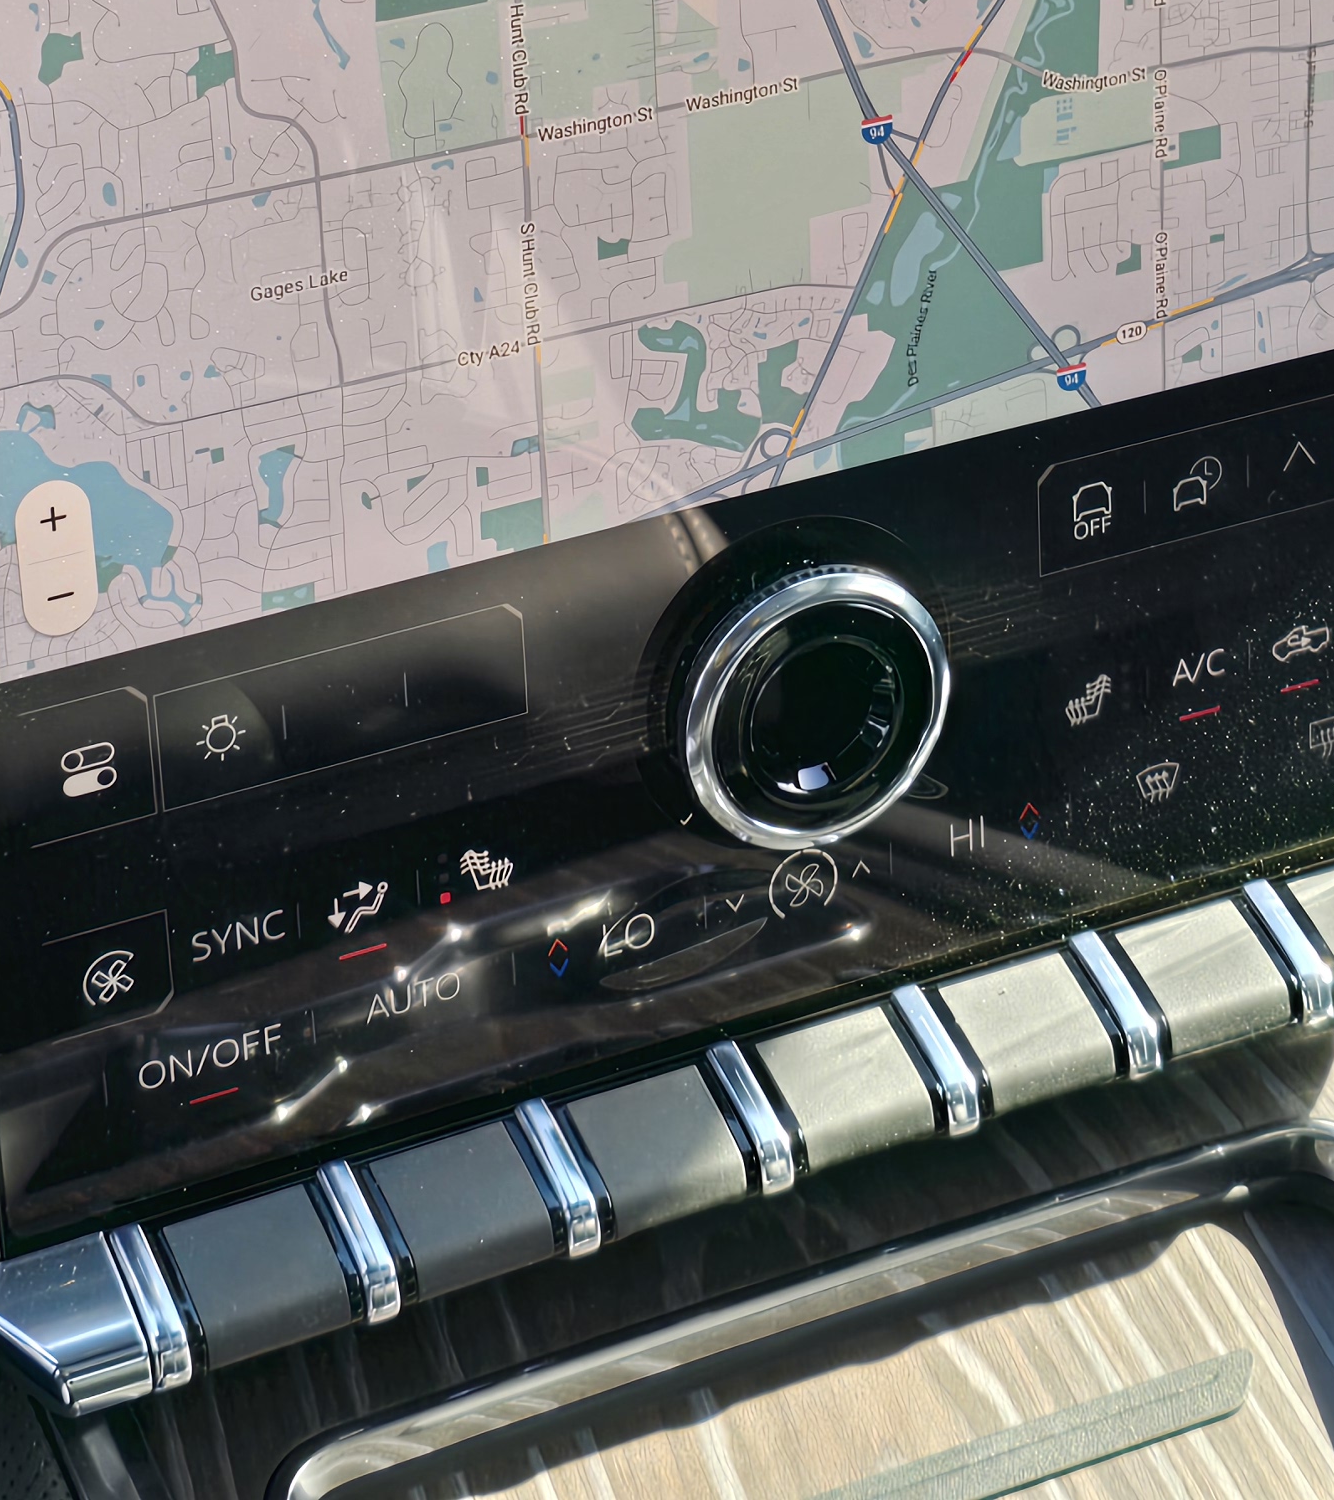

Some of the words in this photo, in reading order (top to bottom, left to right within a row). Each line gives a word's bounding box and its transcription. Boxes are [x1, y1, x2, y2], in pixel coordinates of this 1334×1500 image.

[510, 4, 524, 45] Hunt
[512, 50, 528, 88] Club
[1042, 70, 1127, 92] Washington
[1132, 67, 1146, 82] St
[514, 92, 529, 115] Rd
[686, 82, 778, 111] Washington
[783, 78, 798, 92] St
[1154, 69, 1167, 132] O'Plaine
[537, 113, 632, 142] Washington
[638, 107, 653, 122] St
[869, 125, 884, 139] 94
[1155, 137, 1168, 158] Rd
[521, 222, 535, 234] S
[522, 238, 535, 278] Hunt
[1155, 232, 1168, 296] O'Plaine
[250, 280, 304, 301] Gages
[309, 270, 348, 288] Lake
[524, 283, 539, 320] Club
[1156, 298, 1169, 319] Rd
[526, 324, 541, 346] Rd
[906, 307, 928, 357] Plaines
[1121, 326, 1142, 340] 120
[458, 351, 484, 366] Cty
[489, 340, 520, 359] A24
[1073, 516, 1112, 541] OFF
[1173, 648, 1226, 687] A/C
[951, 815, 984, 857] HI
[192, 910, 286, 962] SYNC
[603, 913, 656, 957] LO
[367, 972, 461, 1025] AUTO
[138, 1023, 283, 1090] ON/OFF
